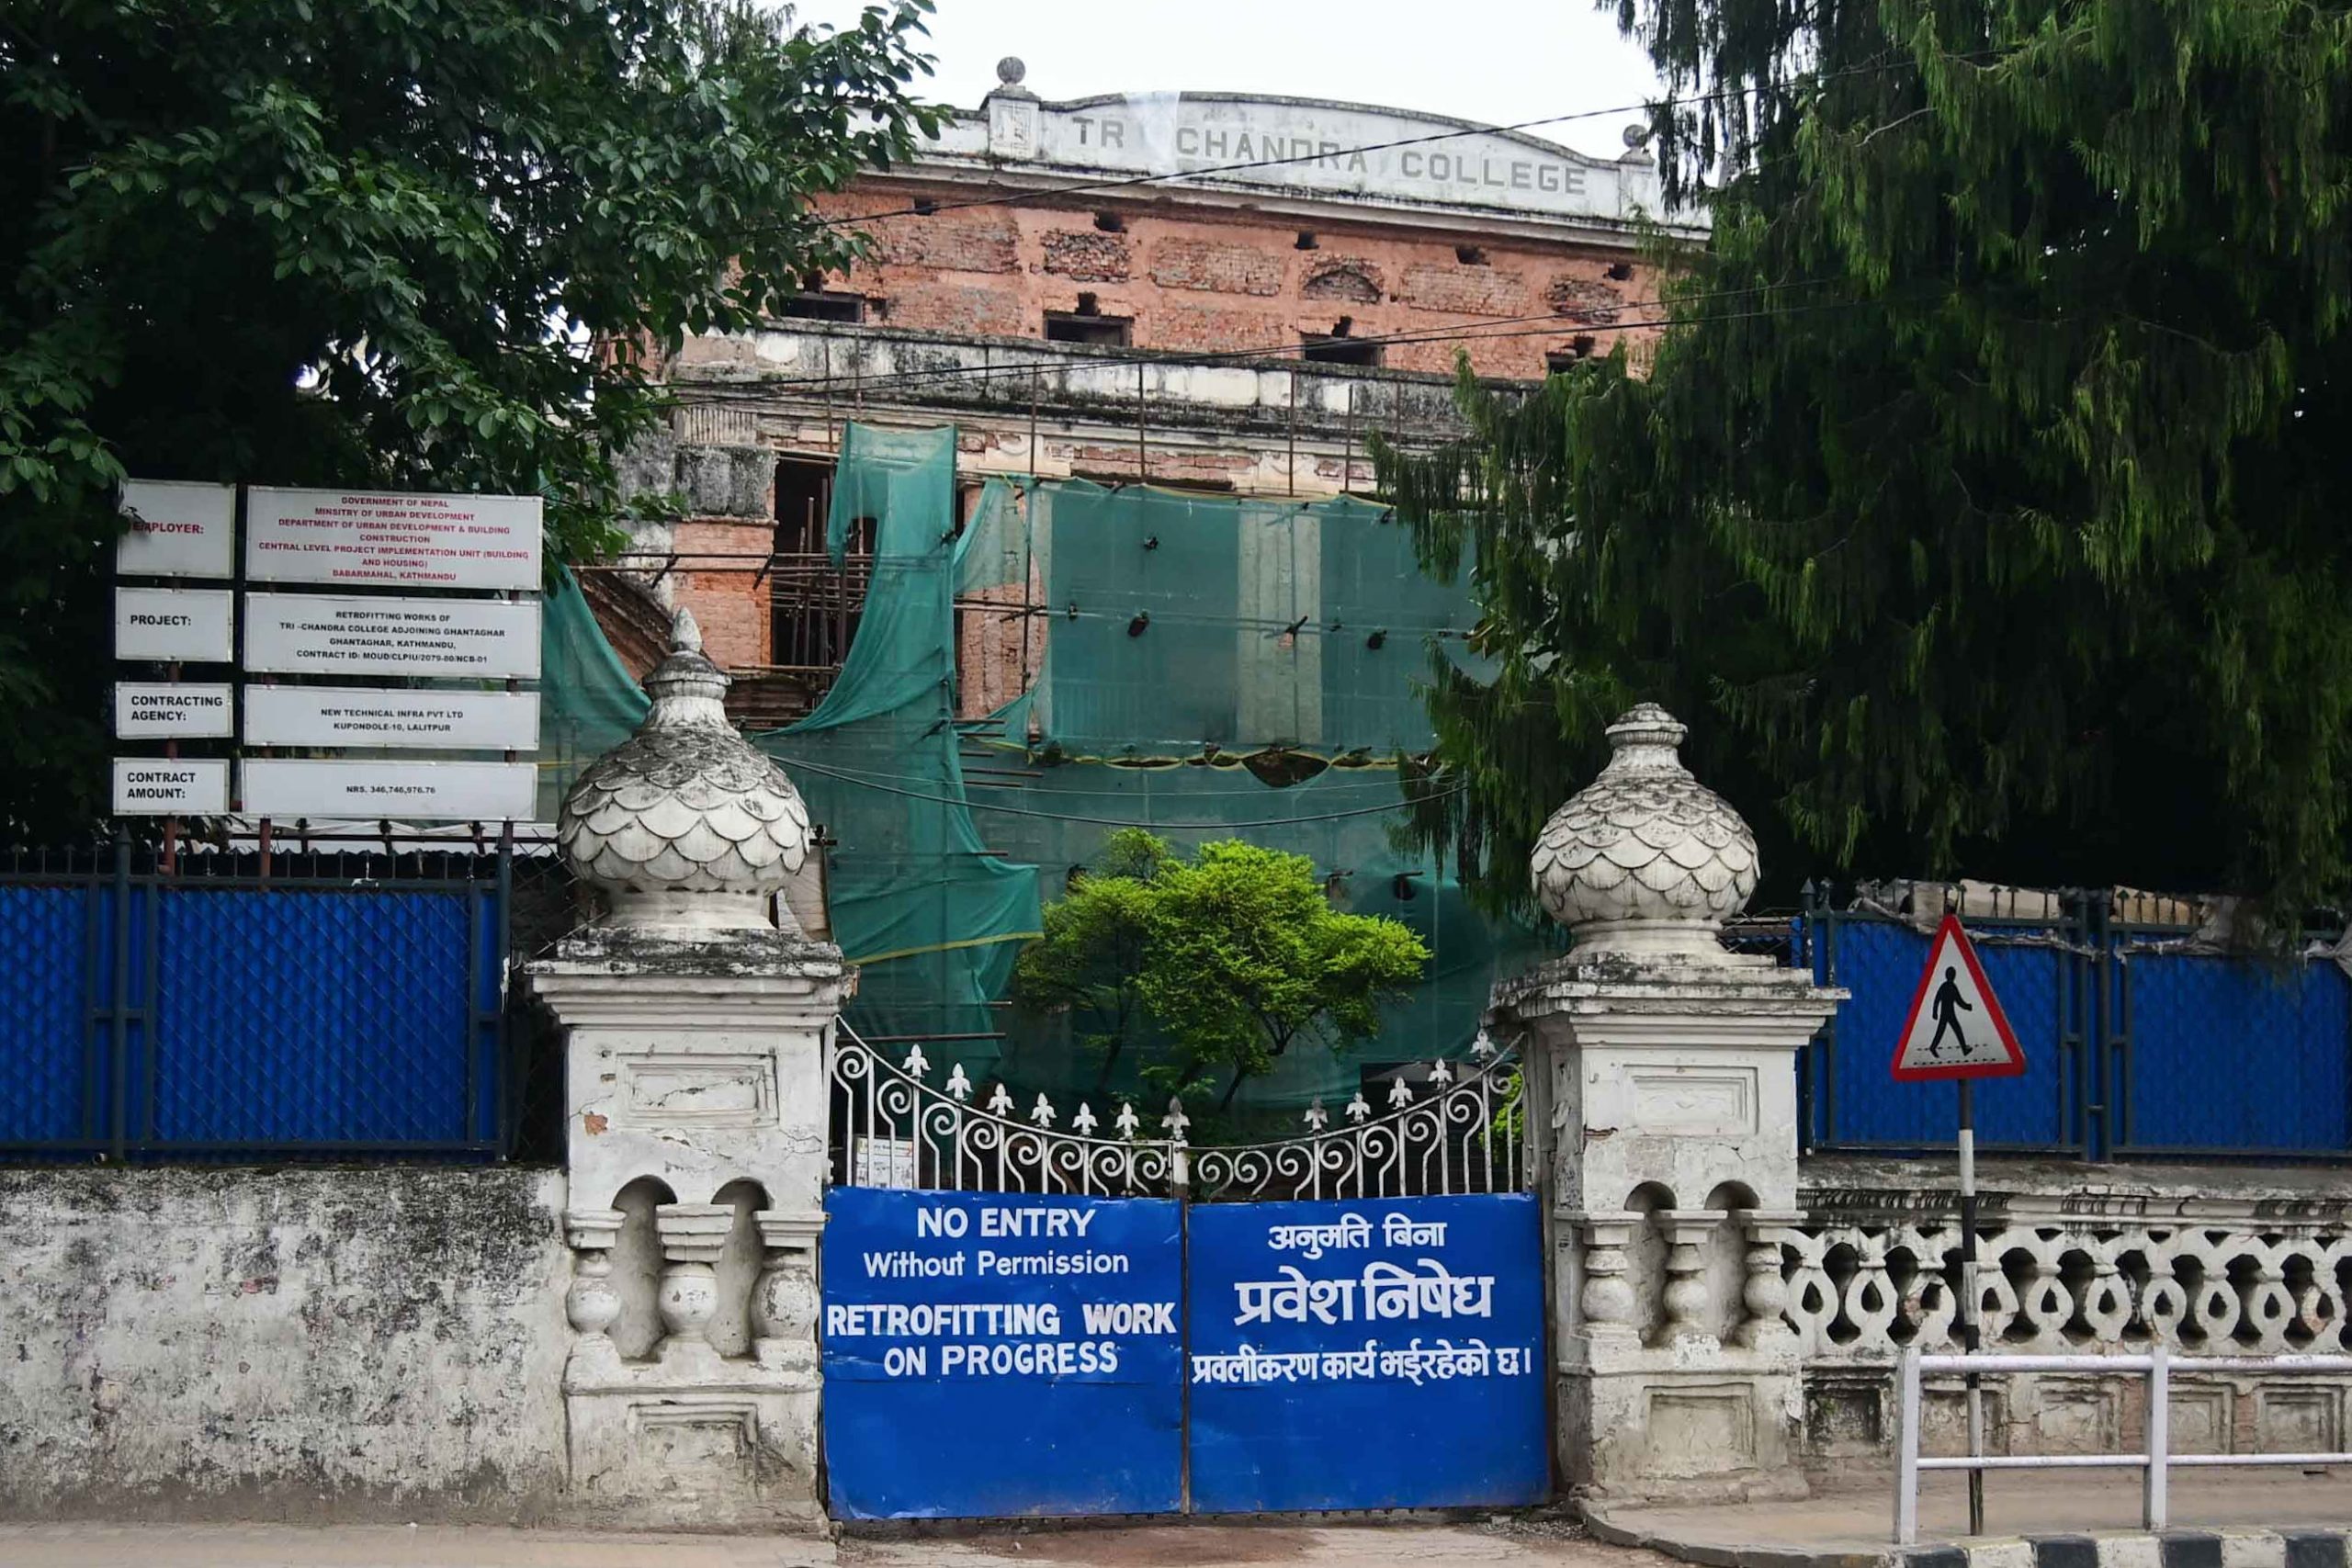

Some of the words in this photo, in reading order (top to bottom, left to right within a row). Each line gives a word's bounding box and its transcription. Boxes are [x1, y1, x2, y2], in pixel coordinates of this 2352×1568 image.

[1177, 128, 1368, 174] CHANDRA
[1401, 150, 1587, 195] COLLEGE
[342, 496, 403, 507] GOVERNMENT
[421, 500, 448, 508] NEPAL
[360, 510, 372, 518] OF
[376, 510, 406, 519] URBAN
[410, 511, 475, 521] DEVELOPMENT
[278, 519, 339, 529] DEPARTMENT
[342, 522, 354, 530] OF
[356, 522, 389, 531] URBAN
[392, 523, 456, 533] DEVELOPMENT
[468, 525, 510, 535] BUILDING
[360, 534, 430, 544] CONSTRUCTION
[259, 542, 300, 552] CENTRAL
[303, 543, 332, 552] LEVEL
[334, 545, 375, 555] PROJECT
[378, 547, 457, 558] IMPLEMENTATION
[459, 550, 480, 558] UNIT
[482, 550, 529, 560] (BUILDING
[362, 558, 380, 567] AND
[383, 558, 428, 568] HOUSING)
[400, 570, 456, 581] KATHMANDU
[130, 615, 191, 626] PROJECT:
[335, 611, 401, 621] RETROFITTING
[404, 612, 437, 622] WORKS
[439, 613, 450, 622] OF
[280, 623, 295, 632] TRI
[347, 625, 390, 635] COLLEGE
[391, 626, 441, 636] ADJOINING
[444, 626, 505, 637] GHANTAGHAR
[330, 637, 395, 649] GHANTAGHAR,
[296, 649, 345, 660] CONTRACT
[348, 651, 361, 661] ID:
[131, 695, 223, 707] CONTRACTING
[131, 710, 187, 722] AGENCY:
[321, 708, 342, 716] NEW
[345, 708, 394, 718] TECHNICAL
[397, 709, 424, 718] INFRA
[426, 710, 444, 718] PVT
[447, 710, 463, 718] LTD
[407, 723, 450, 732] LALITPUR
[128, 772, 196, 784] CONTRACT
[128, 787, 186, 800] AMOUNT:
[918, 1207, 968, 1238] NO
[980, 1208, 1095, 1237] ENTRY
[1269, 1213, 1373, 1259] अनुमति
[1382, 1213, 1447, 1247] बिना
[864, 1251, 966, 1278] Without
[978, 1249, 1129, 1276] Permission
[1234, 1265, 1357, 1325] प्रवेश
[1362, 1258, 1494, 1321] निषेध
[827, 1303, 1060, 1337] RETROFITTING
[1082, 1302, 1177, 1334] WORK
[884, 1346, 926, 1377] ON
[942, 1341, 1118, 1376] PROGRESS
[1322, 1340, 1377, 1379] कार्य
